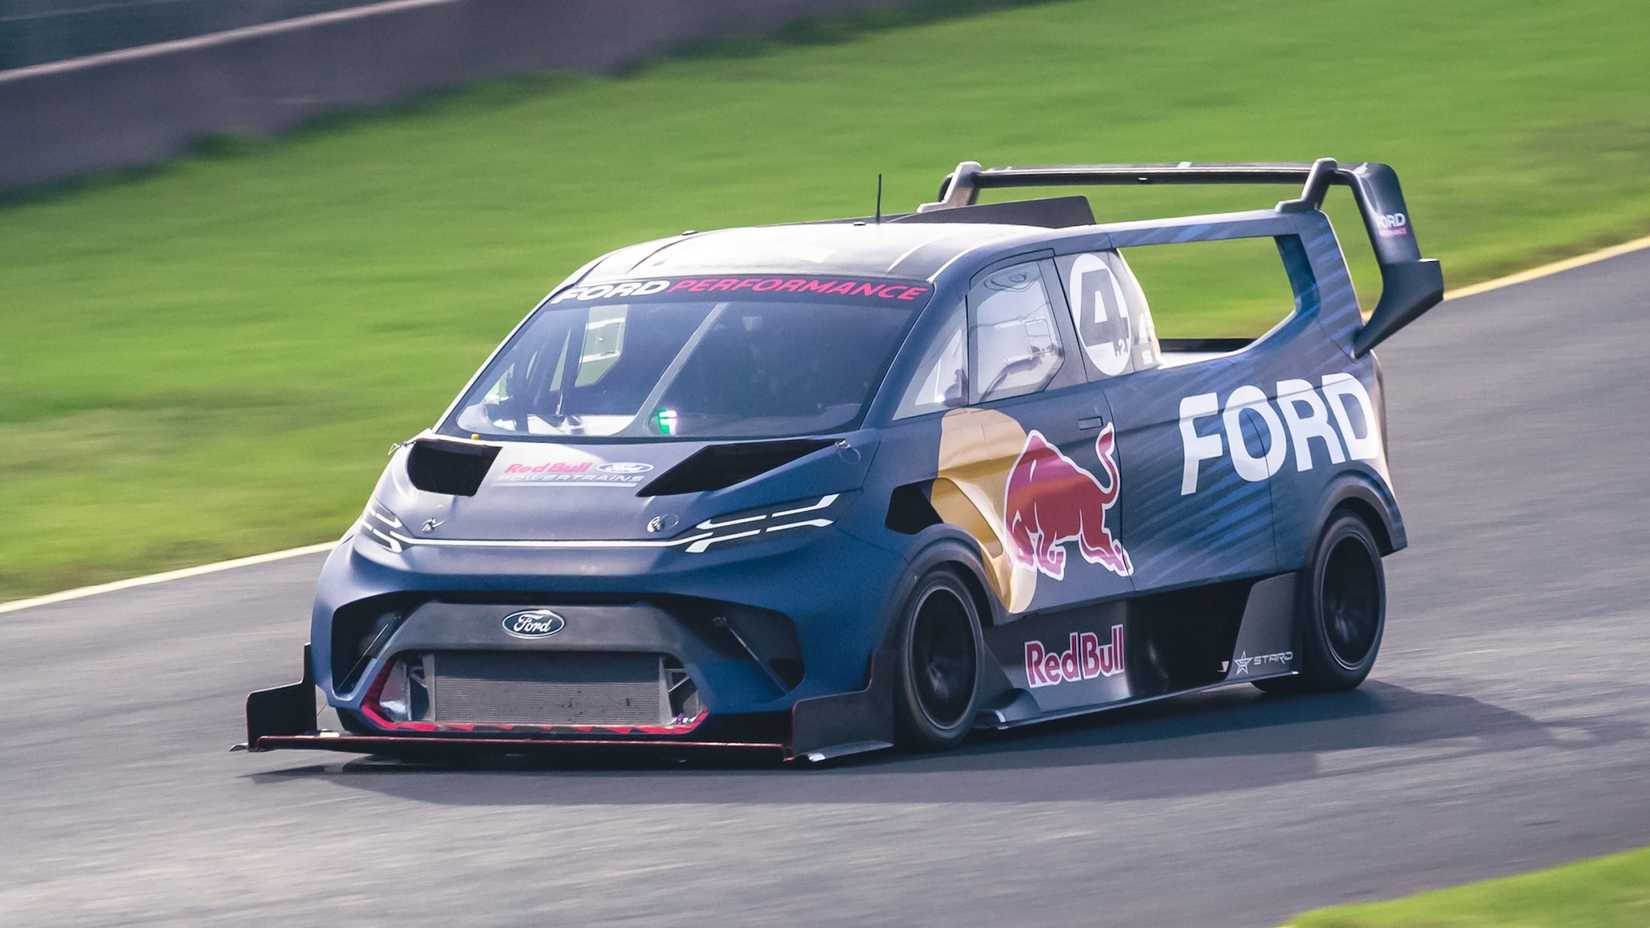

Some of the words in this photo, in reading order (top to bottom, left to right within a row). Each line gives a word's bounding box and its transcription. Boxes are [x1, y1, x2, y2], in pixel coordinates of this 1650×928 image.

[550, 280, 671, 305] FORD
[666, 277, 930, 302] PERFORMANCE
[1178, 372, 1380, 496] FORD
[513, 614, 553, 633] Ford
[1253, 650, 1294, 666] STARD
